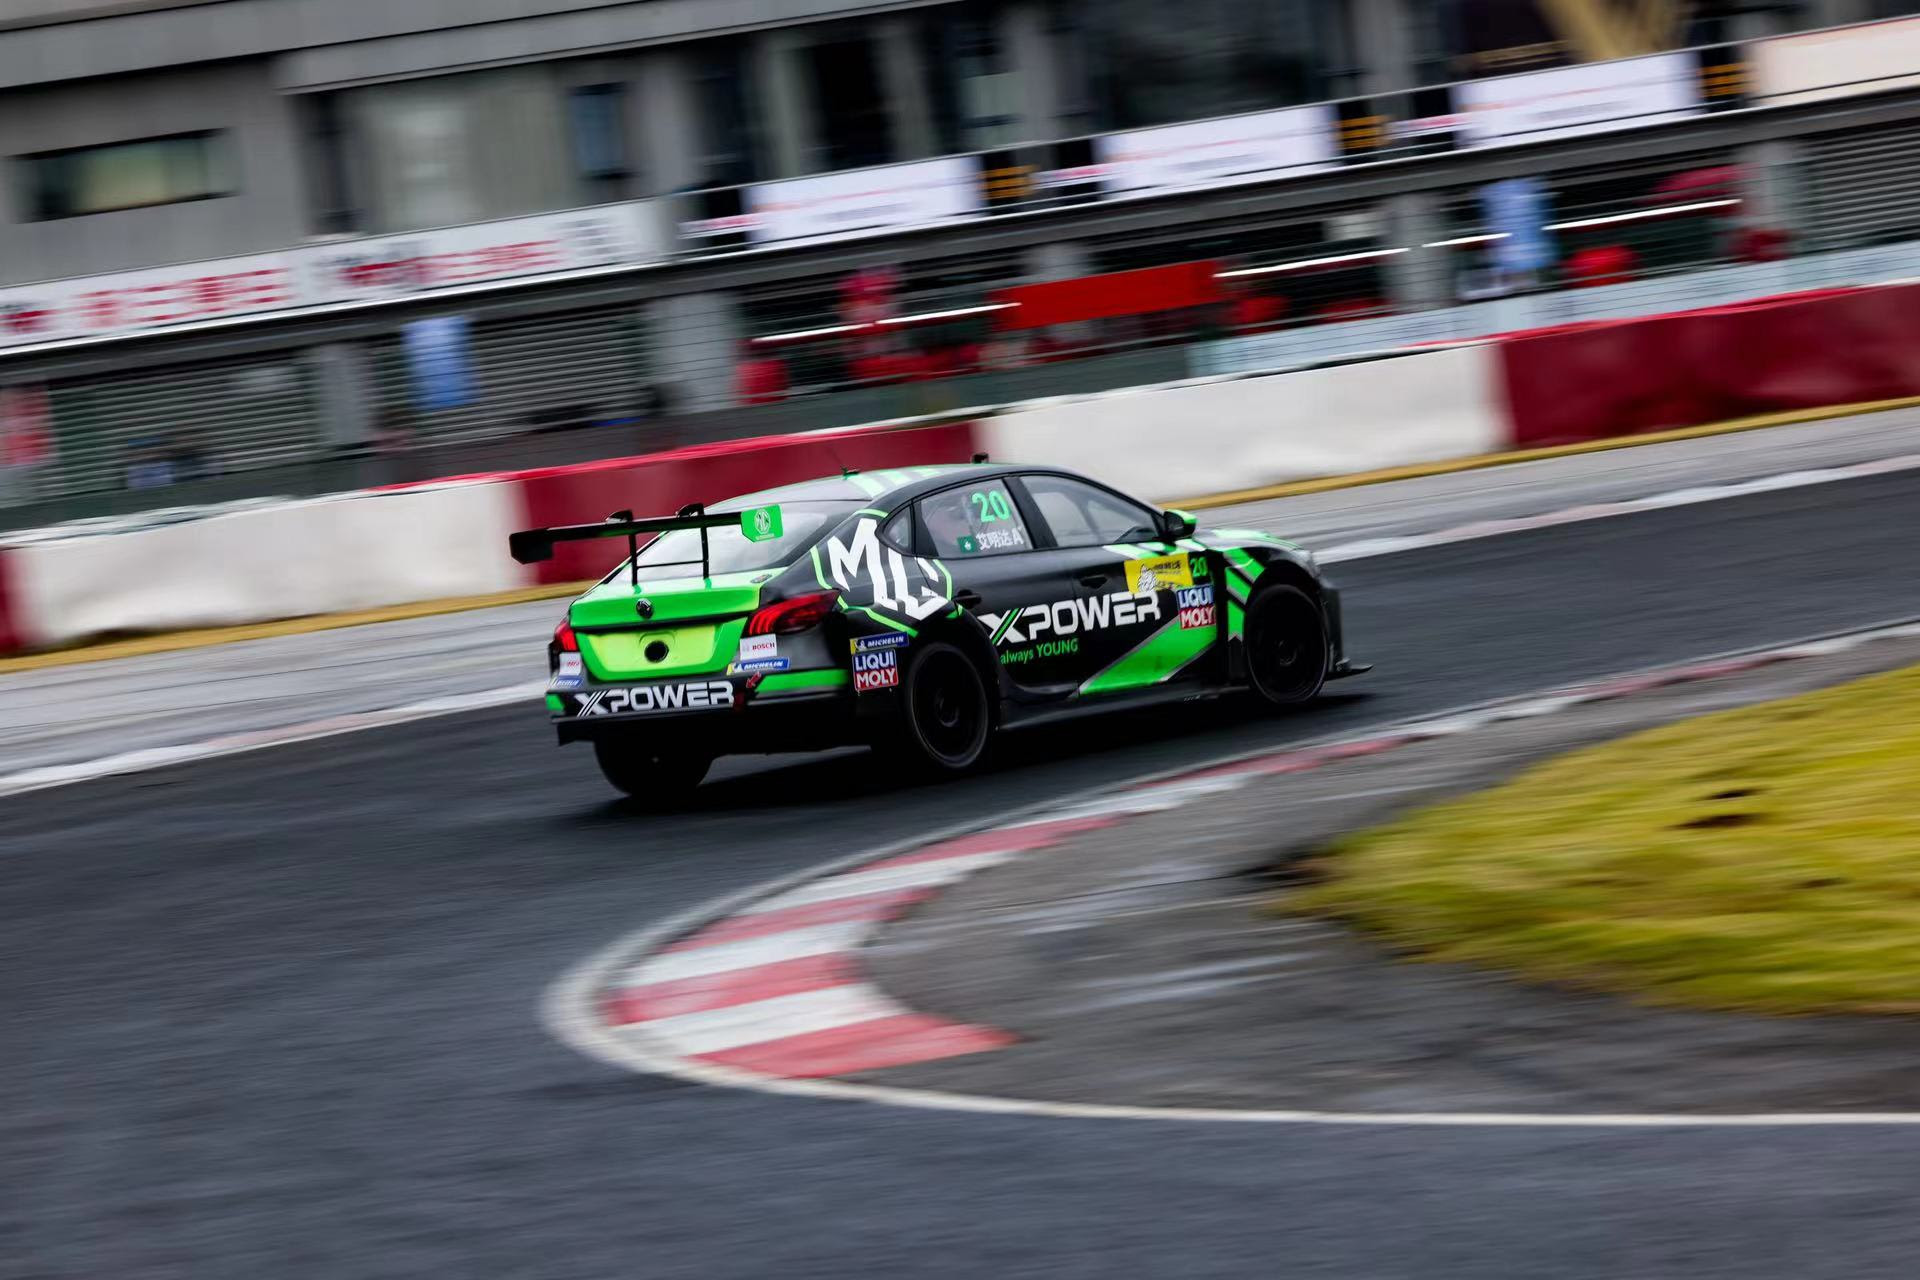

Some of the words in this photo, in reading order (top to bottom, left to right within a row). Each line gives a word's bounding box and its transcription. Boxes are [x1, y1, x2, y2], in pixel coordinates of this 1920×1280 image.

[972, 491, 1010, 522] 20
[1190, 557, 1208, 577] 20
[1178, 587, 1213, 608] LIQUI
[977, 591, 1161, 646] XPOWER
[1180, 606, 1215, 629] MOLY
[752, 642, 775, 651] BOSCH
[867, 636, 904, 647] MICHELIN
[1000, 649, 1034, 664] always
[1036, 638, 1079, 658] YOUNG
[855, 651, 894, 671] LIQUI
[856, 668, 896, 688] MOLY
[574, 681, 735, 717] XPOWER
